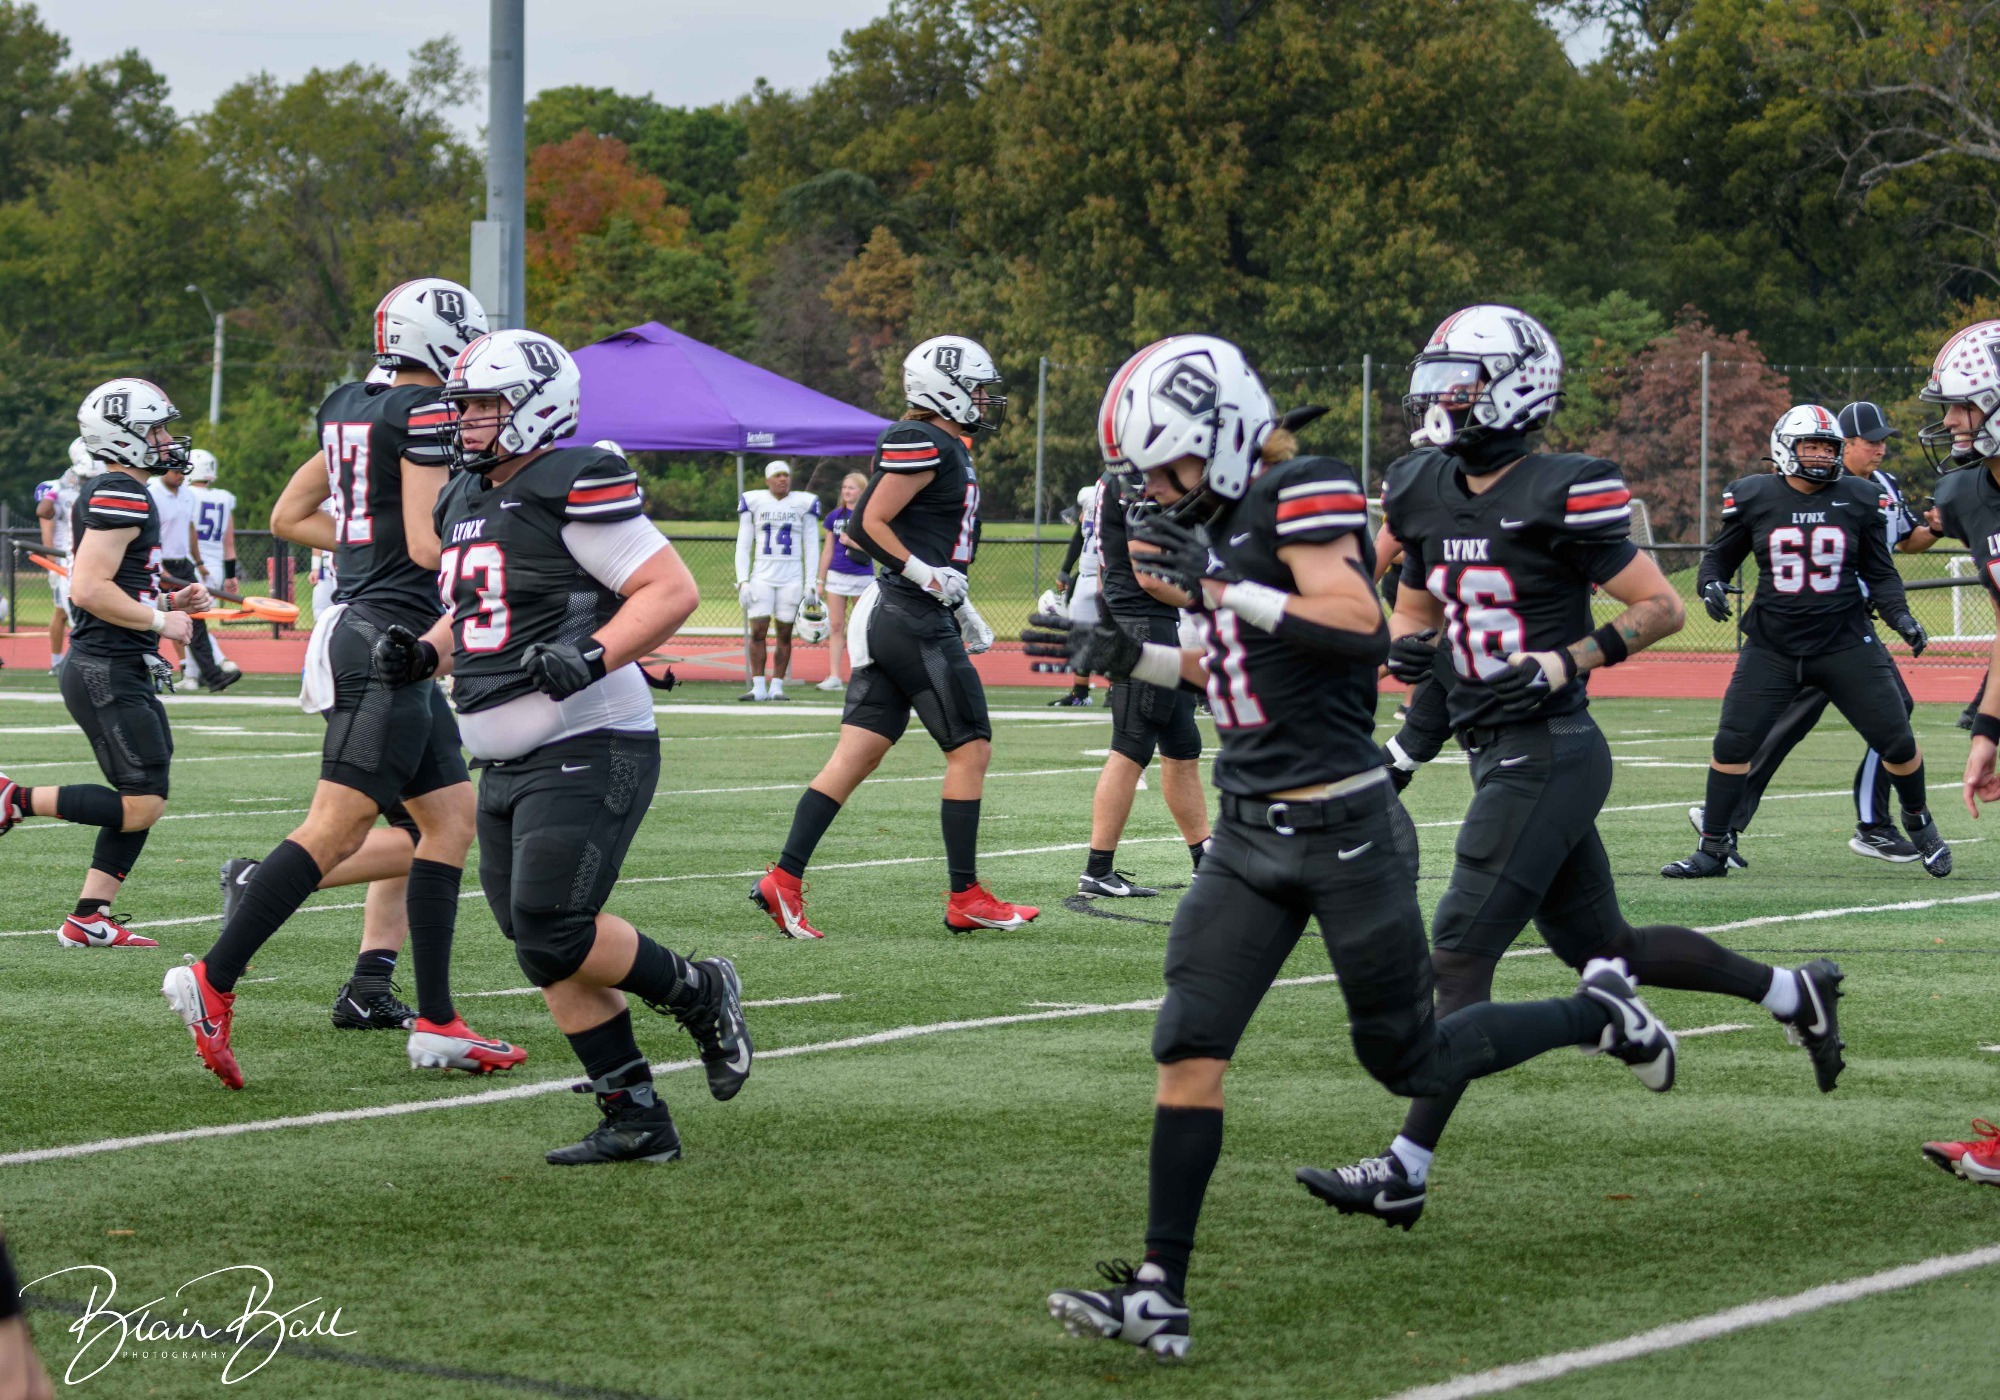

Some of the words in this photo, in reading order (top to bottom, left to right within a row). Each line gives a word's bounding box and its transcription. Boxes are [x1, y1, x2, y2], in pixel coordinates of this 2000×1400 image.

[389, 335, 401, 344] 87
[197, 501, 224, 541] 51
[451, 518, 486, 542] LYNX
[1792, 512, 1826, 524] LYNX
[761, 522, 793, 556] 14
[1443, 538, 1489, 561] LYNX
[1769, 526, 1846, 593] 69
[1426, 564, 1526, 681] 16
